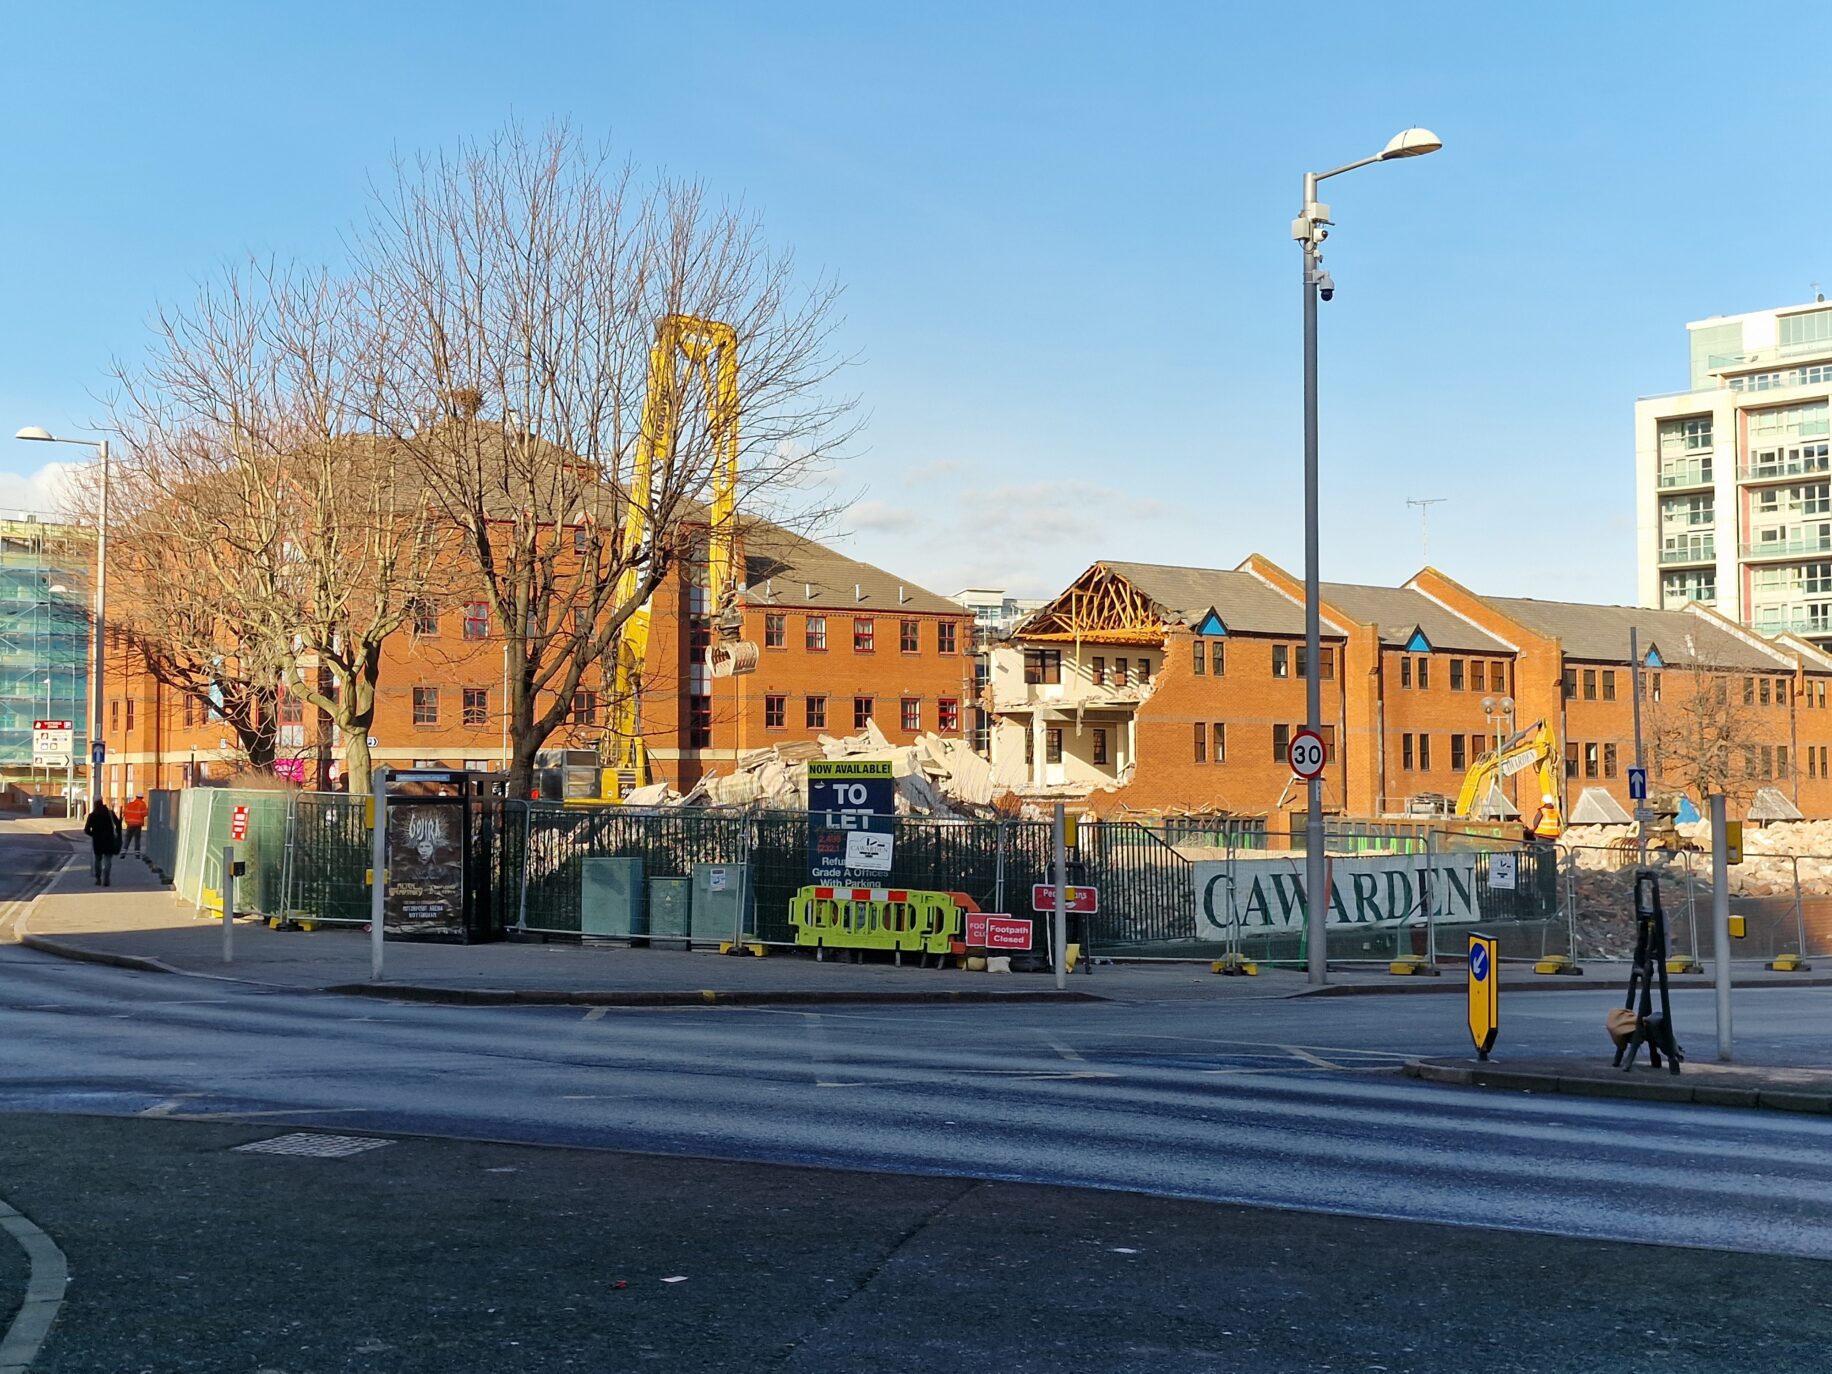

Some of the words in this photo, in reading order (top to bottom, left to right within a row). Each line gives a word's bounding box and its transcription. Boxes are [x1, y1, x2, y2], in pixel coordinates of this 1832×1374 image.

[1294, 745, 1321, 765] 30
[809, 764, 832, 774] NOW
[835, 763, 891, 774] AVAILABLE!
[832, 783, 868, 805] TO
[826, 808, 874, 830] LET
[409, 813, 441, 840] GOJIRA
[850, 844, 888, 853] CAWARDEN
[811, 867, 841, 877] Grade
[843, 868, 852, 877] A
[853, 868, 889, 878] Offices
[819, 878, 843, 887] With
[844, 879, 882, 888] Parking
[1203, 866, 1474, 929] CAWARDEN
[989, 925, 1029, 935] Footpath
[993, 935, 1025, 944] Closed
